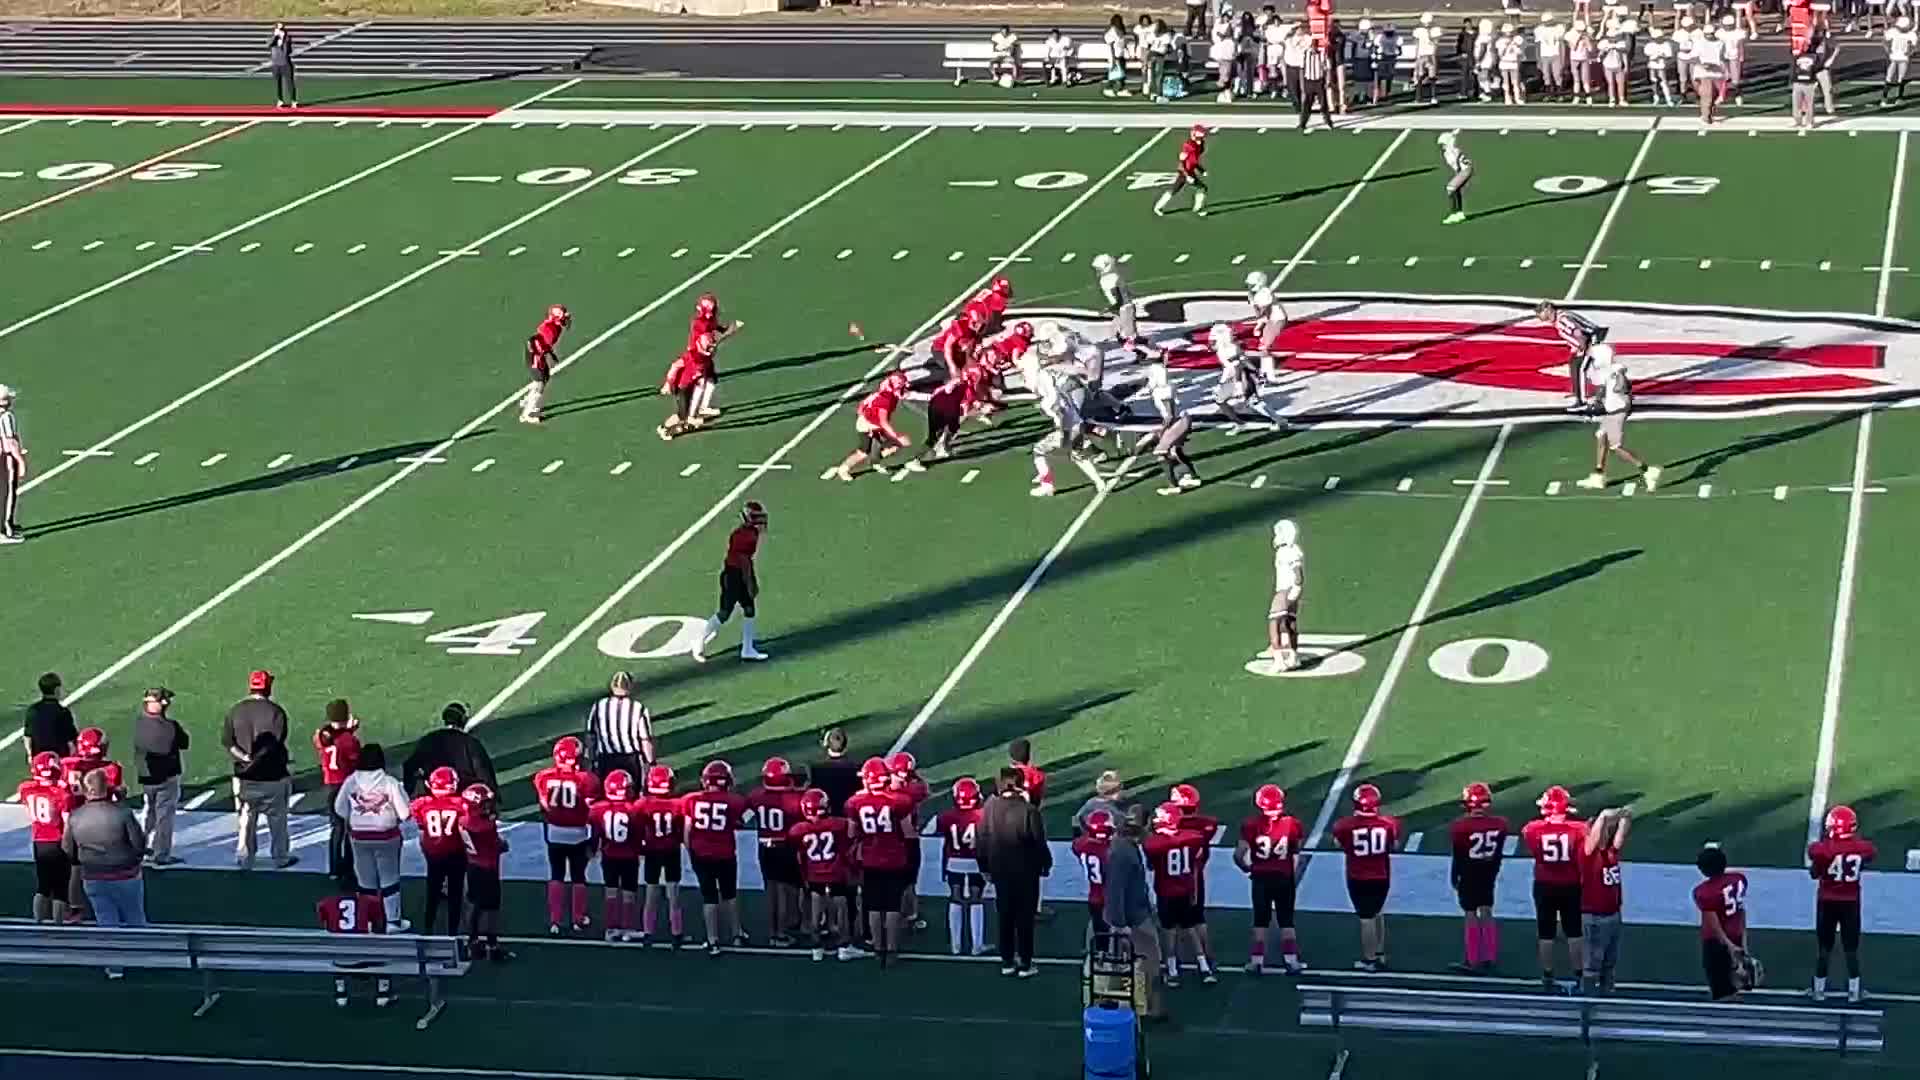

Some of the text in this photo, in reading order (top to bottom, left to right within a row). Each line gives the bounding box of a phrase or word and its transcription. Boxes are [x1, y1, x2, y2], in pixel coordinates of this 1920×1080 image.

[324, 745, 338, 770] 7
[26, 794, 51, 823] 18
[546, 780, 577, 809] 70
[425, 810, 457, 837] 87
[603, 811, 629, 842] 16
[653, 812, 673, 837] 11
[694, 802, 728, 831] 55
[757, 805, 784, 832] 10
[859, 805, 892, 833] 64
[802, 831, 835, 862] 22
[950, 823, 976, 850] 14
[1255, 835, 1289, 860] 34
[1352, 827, 1387, 857] 50
[1468, 830, 1500, 860] 25
[1542, 833, 1571, 863] 51
[1168, 846, 1191, 876] 81
[1827, 853, 1863, 882] 43
[338, 899, 356, 930] 3
